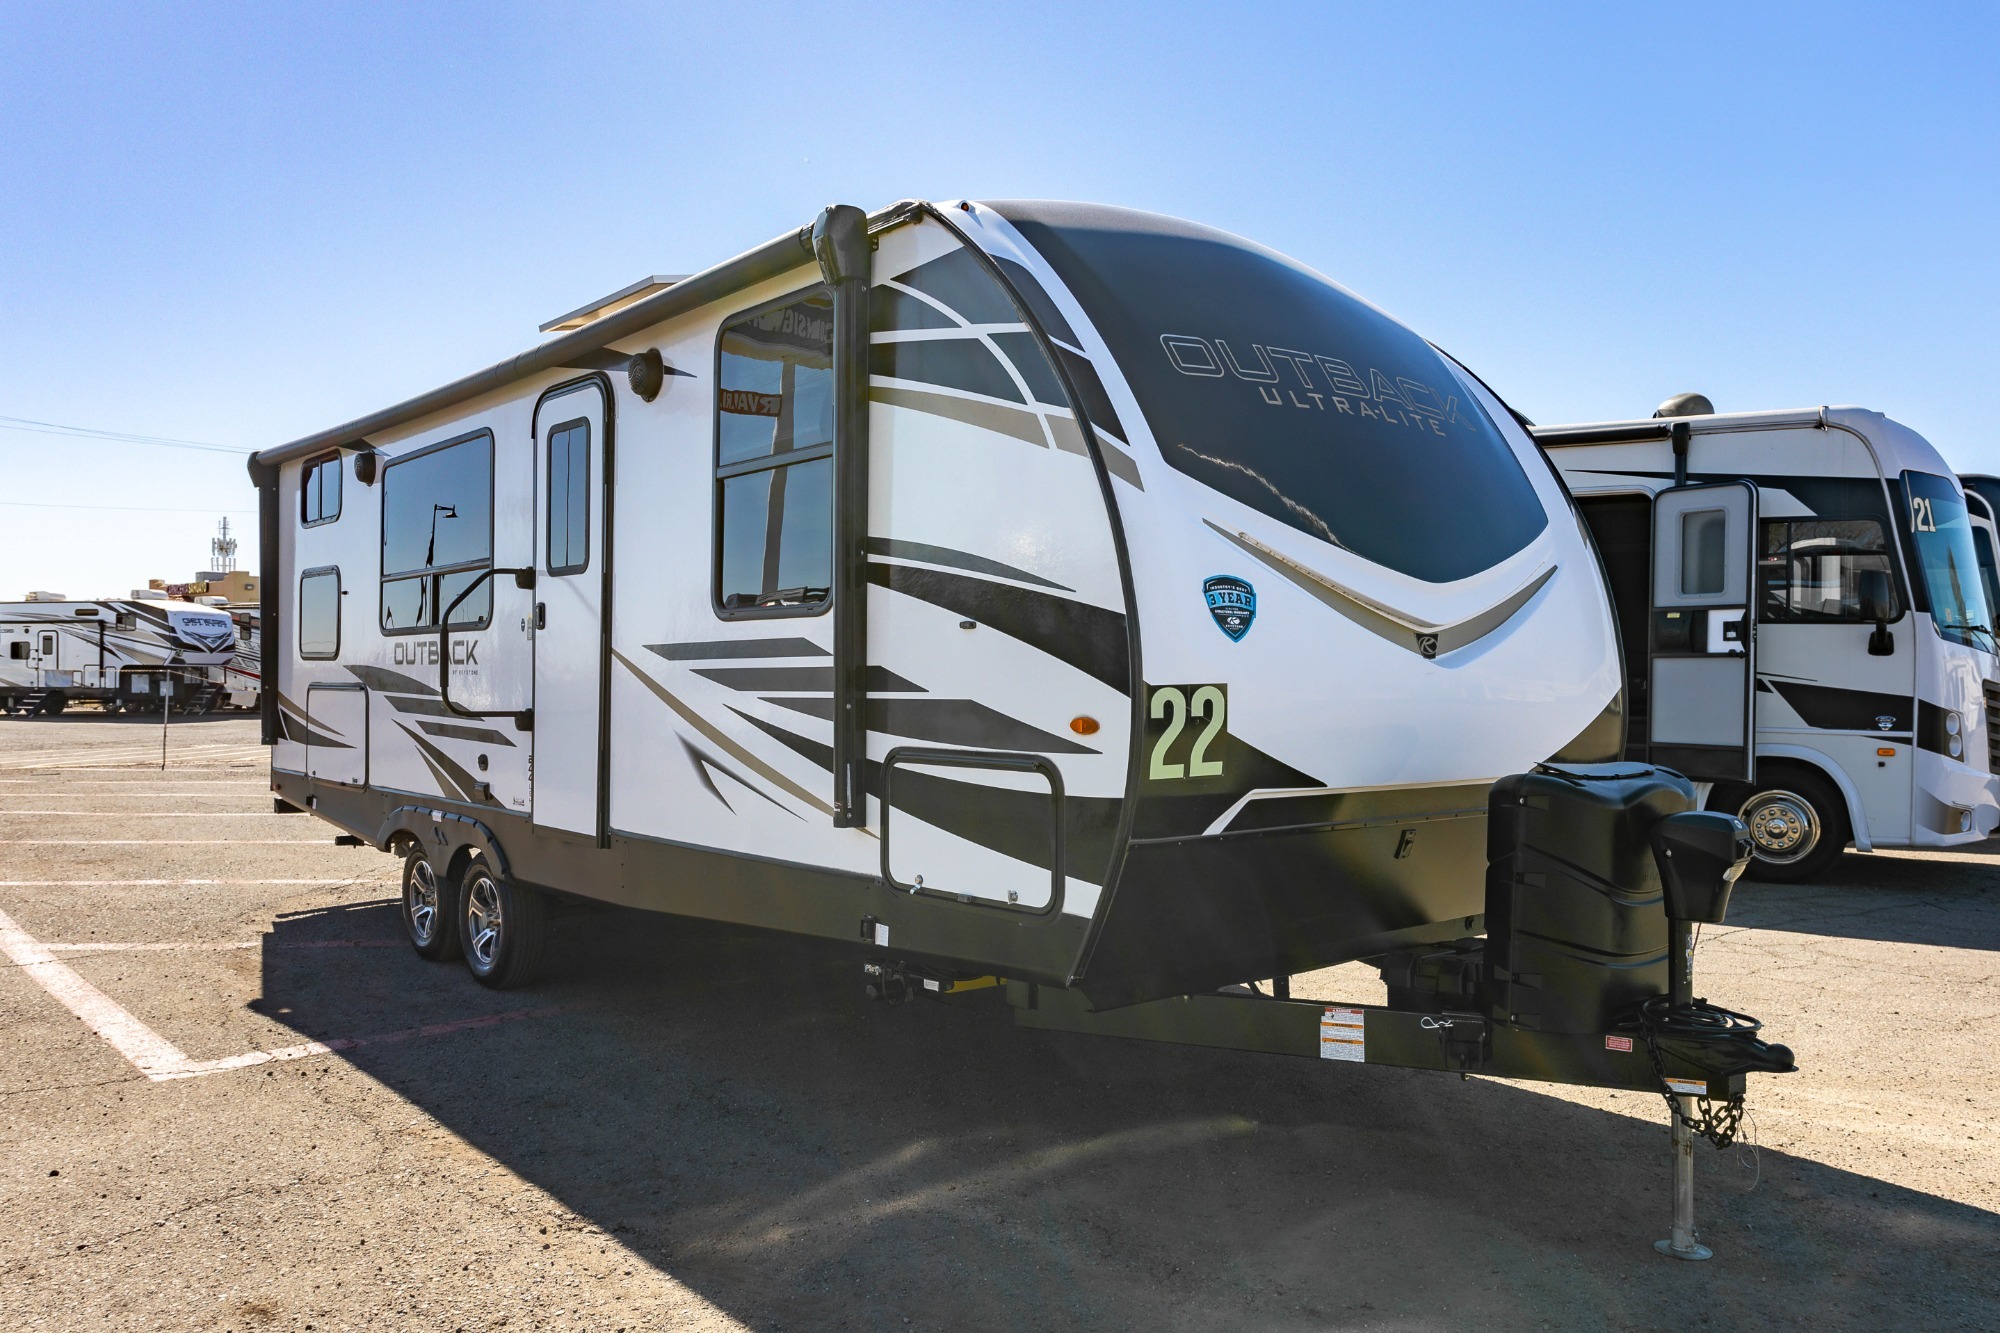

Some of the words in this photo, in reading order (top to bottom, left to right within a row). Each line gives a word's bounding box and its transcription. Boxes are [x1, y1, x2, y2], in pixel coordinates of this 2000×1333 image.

[1160, 334, 1476, 431] OUTBACK
[1209, 594, 1216, 605] 3
[1218, 592, 1252, 607] YEAR
[394, 640, 479, 665] OUTBCK
[1149, 686, 1225, 780] 22
